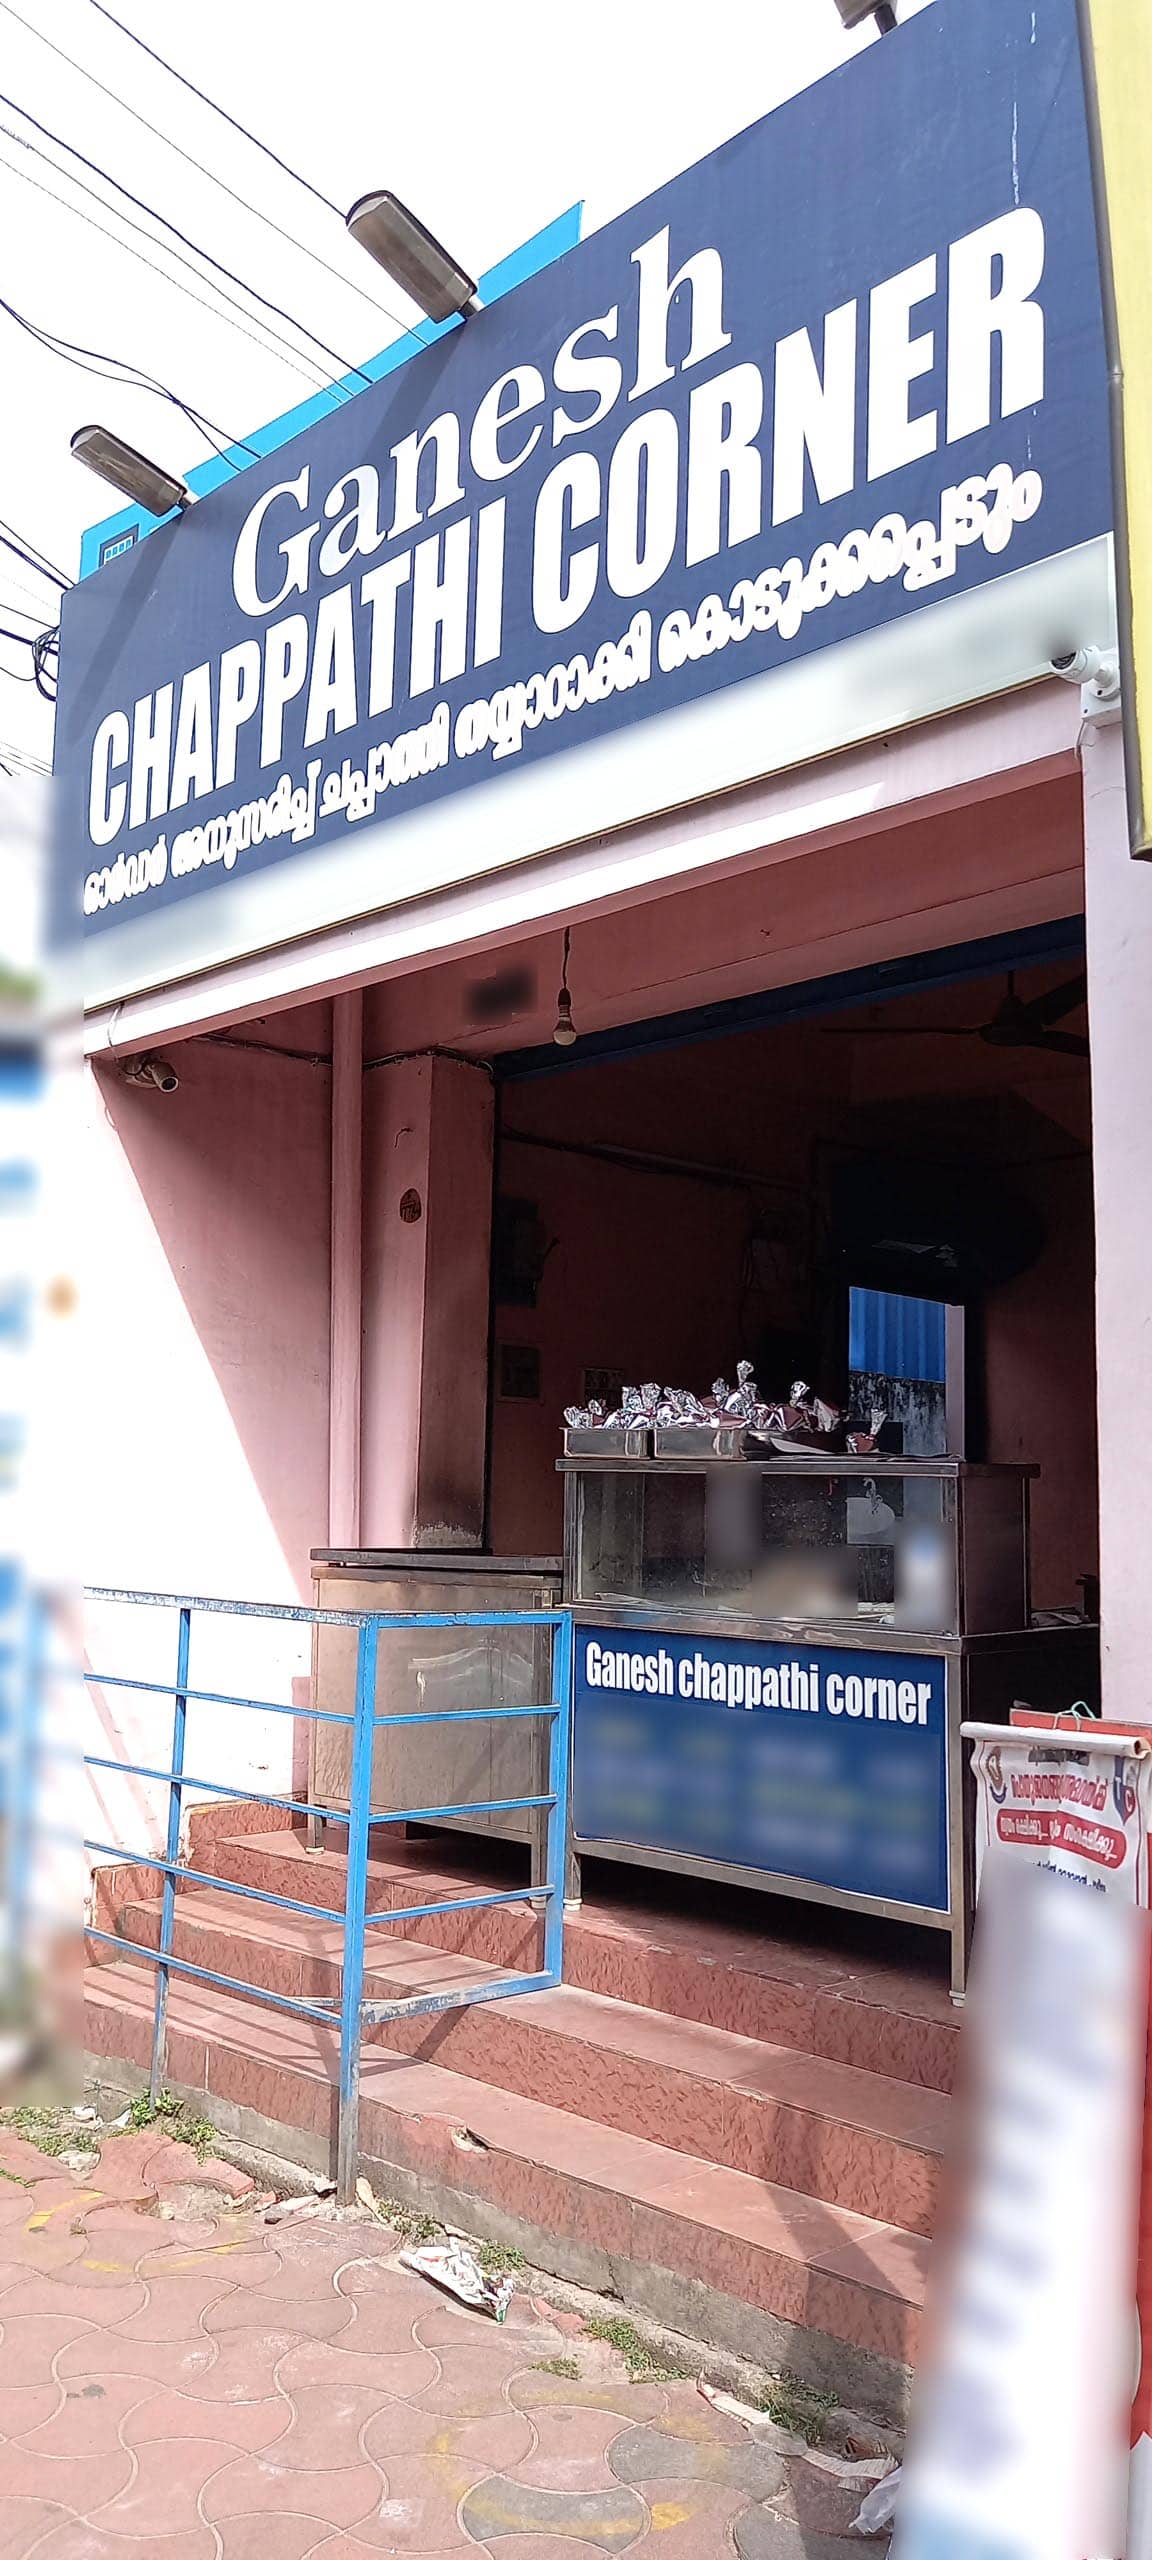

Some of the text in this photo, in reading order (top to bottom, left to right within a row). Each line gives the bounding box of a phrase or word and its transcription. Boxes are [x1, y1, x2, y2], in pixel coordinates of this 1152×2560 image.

[89, 207, 1045, 846] CHAPPATHI CORNER
[233, 225, 732, 616] Ganesh
[319, 701, 450, 822] ചപ്പാത്തി
[454, 609, 652, 761] തയ്യാറാക്കി
[586, 1641, 931, 1725] Ganesh chappathi corner
